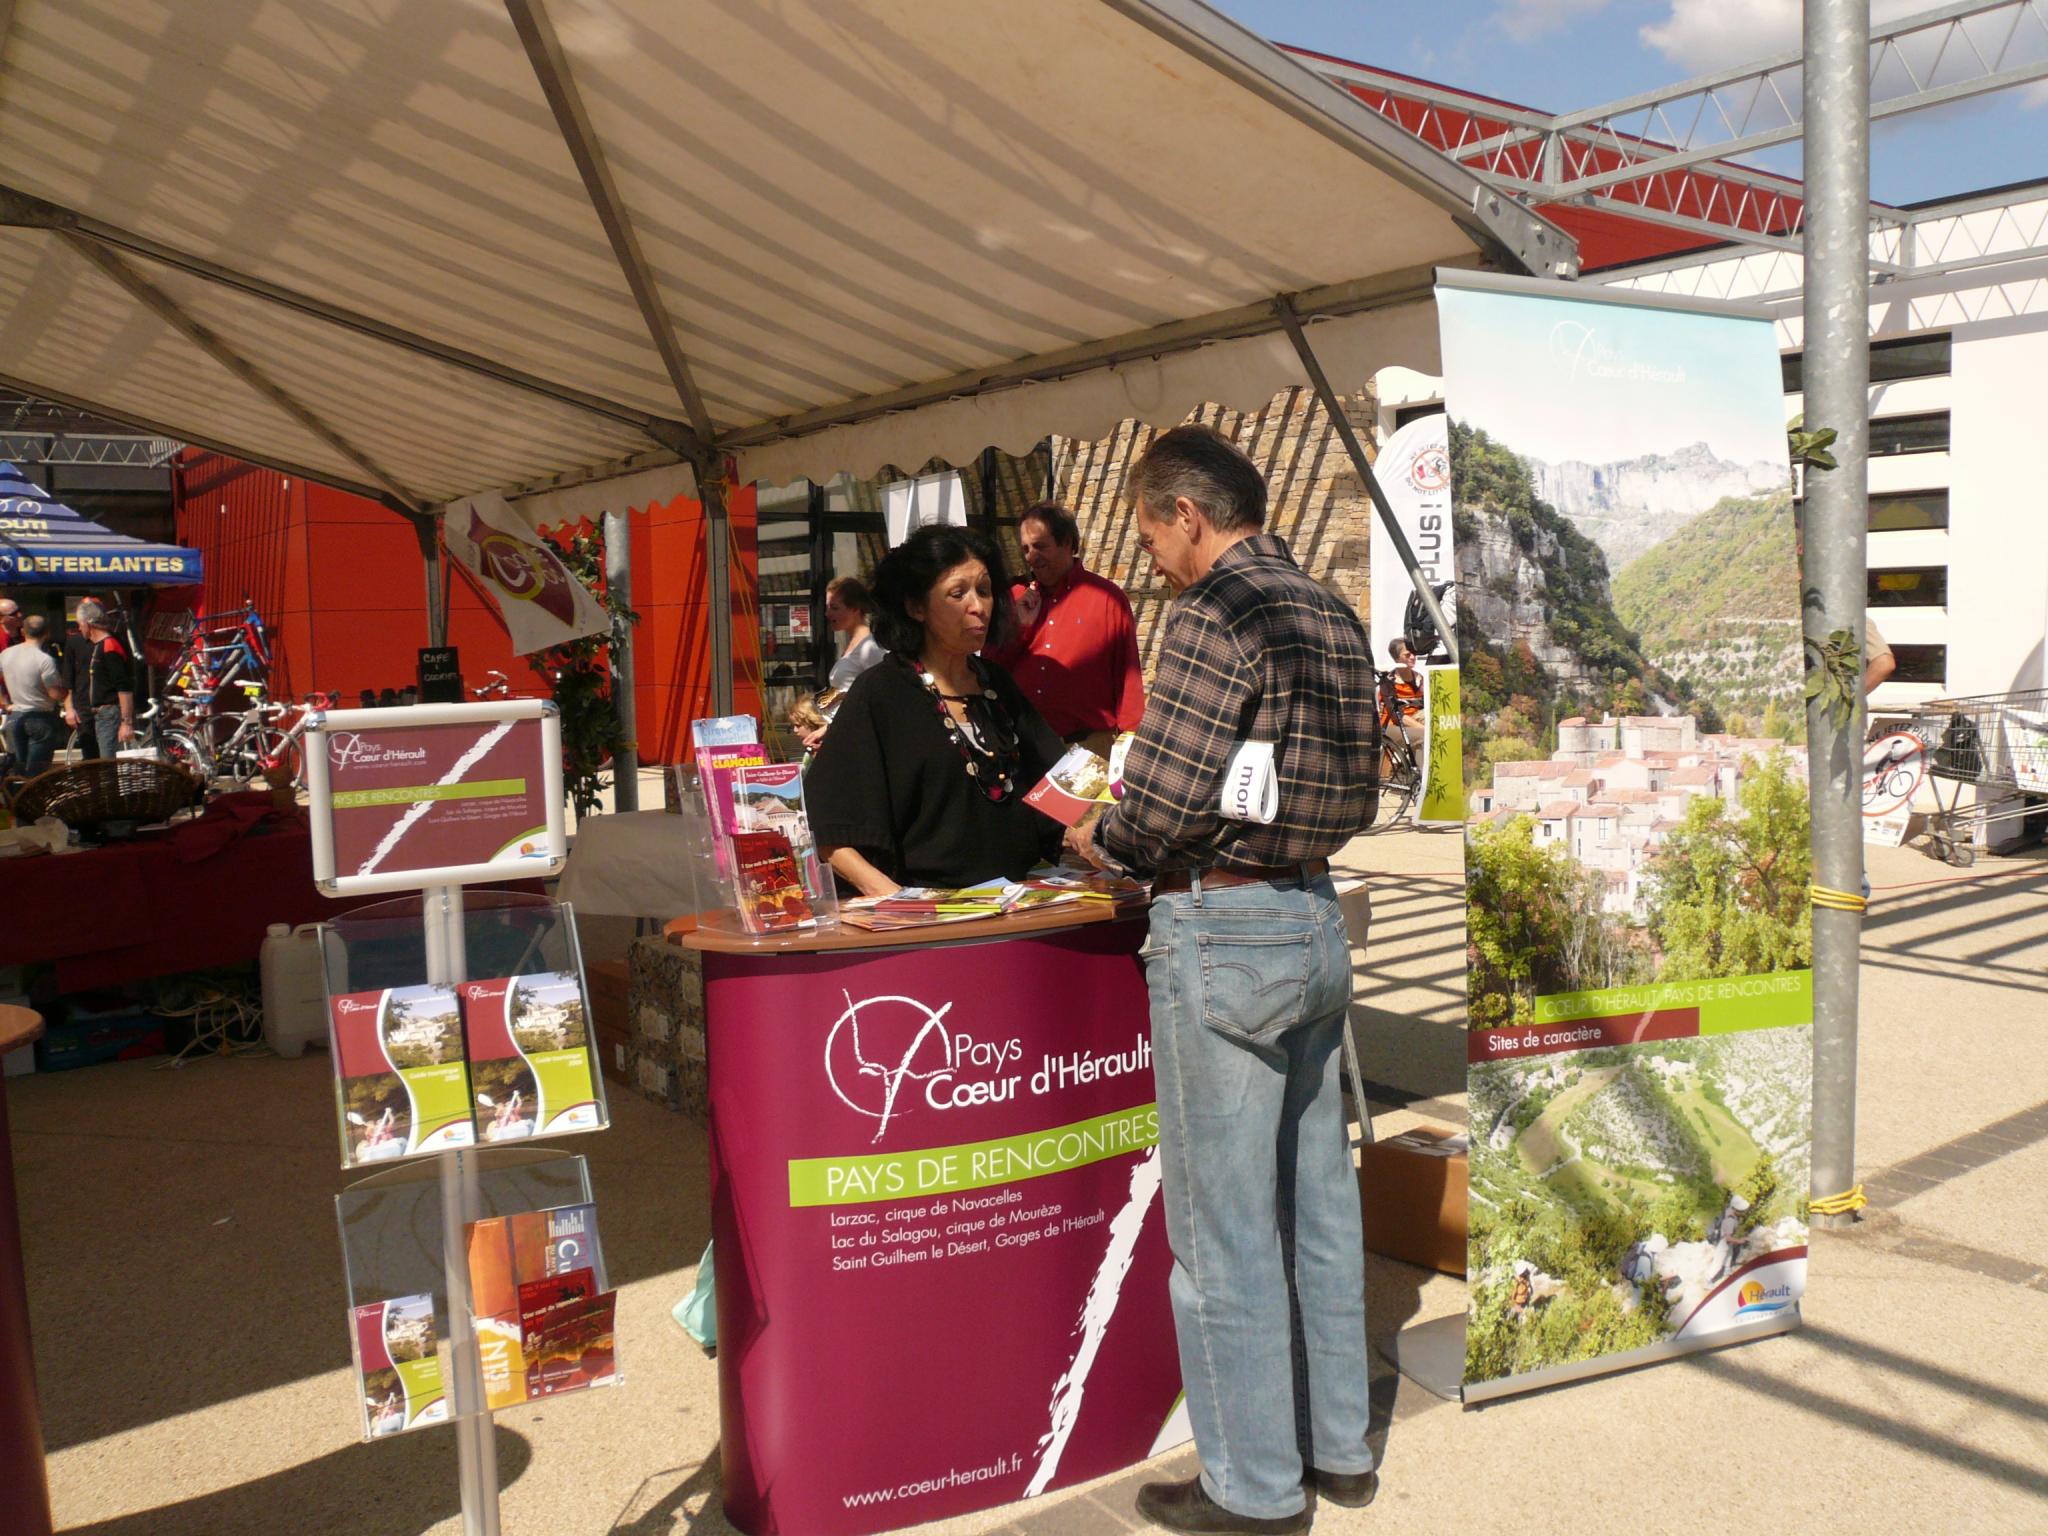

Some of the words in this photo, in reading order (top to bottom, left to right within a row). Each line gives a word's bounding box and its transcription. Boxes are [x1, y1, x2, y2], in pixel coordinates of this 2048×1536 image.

[17, 556, 184, 572] DEFERLANTES
[1439, 715, 1461, 731] RAN
[352, 752, 380, 763] Cœur
[383, 747, 426, 760] d'Hérault
[360, 742, 381, 753] Pays
[713, 756, 764, 768] CLAMOUSE
[355, 793, 368, 803] DE
[371, 787, 441, 802] RENCONTRES
[1664, 986, 1694, 1003] PAYS
[1698, 985, 1714, 1001] DE
[1718, 976, 1801, 999] RENCONTRES
[1489, 1034, 1519, 1052] Sites
[1523, 1030, 1540, 1048] de
[1543, 1025, 1602, 1046] caractère
[955, 1034, 1022, 1073] Pays
[925, 1074, 1021, 1111] Cœur
[1031, 1033, 1152, 1096] d'Hérault
[827, 1163, 904, 1197] PAYS
[918, 1155, 958, 1189] DE
[972, 1111, 1160, 1181] RENCONTRES
[831, 1212, 880, 1228] Larzac,
[885, 1207, 927, 1223] cirque
[930, 1201, 949, 1216] de
[952, 1190, 1023, 1213] Navacelles
[831, 1234, 855, 1249] Lac
[859, 1231, 877, 1246] du
[881, 1227, 942, 1246] Salagou,
[945, 1219, 986, 1236] cirque
[989, 1213, 1006, 1227] de
[1009, 1203, 1062, 1225] Mourèze
[832, 1255, 867, 1271] Saint
[871, 1248, 927, 1267] Guilhem
[931, 1244, 944, 1259] le
[947, 1239, 991, 1258] Désert,
[995, 1230, 1041, 1248] Gorges
[1043, 1222, 1060, 1238] de
[1063, 1208, 1105, 1233] l'Hérault
[1750, 1284, 1791, 1302] Hérault
[842, 1452, 1023, 1509] www.coeur-herault.fr
